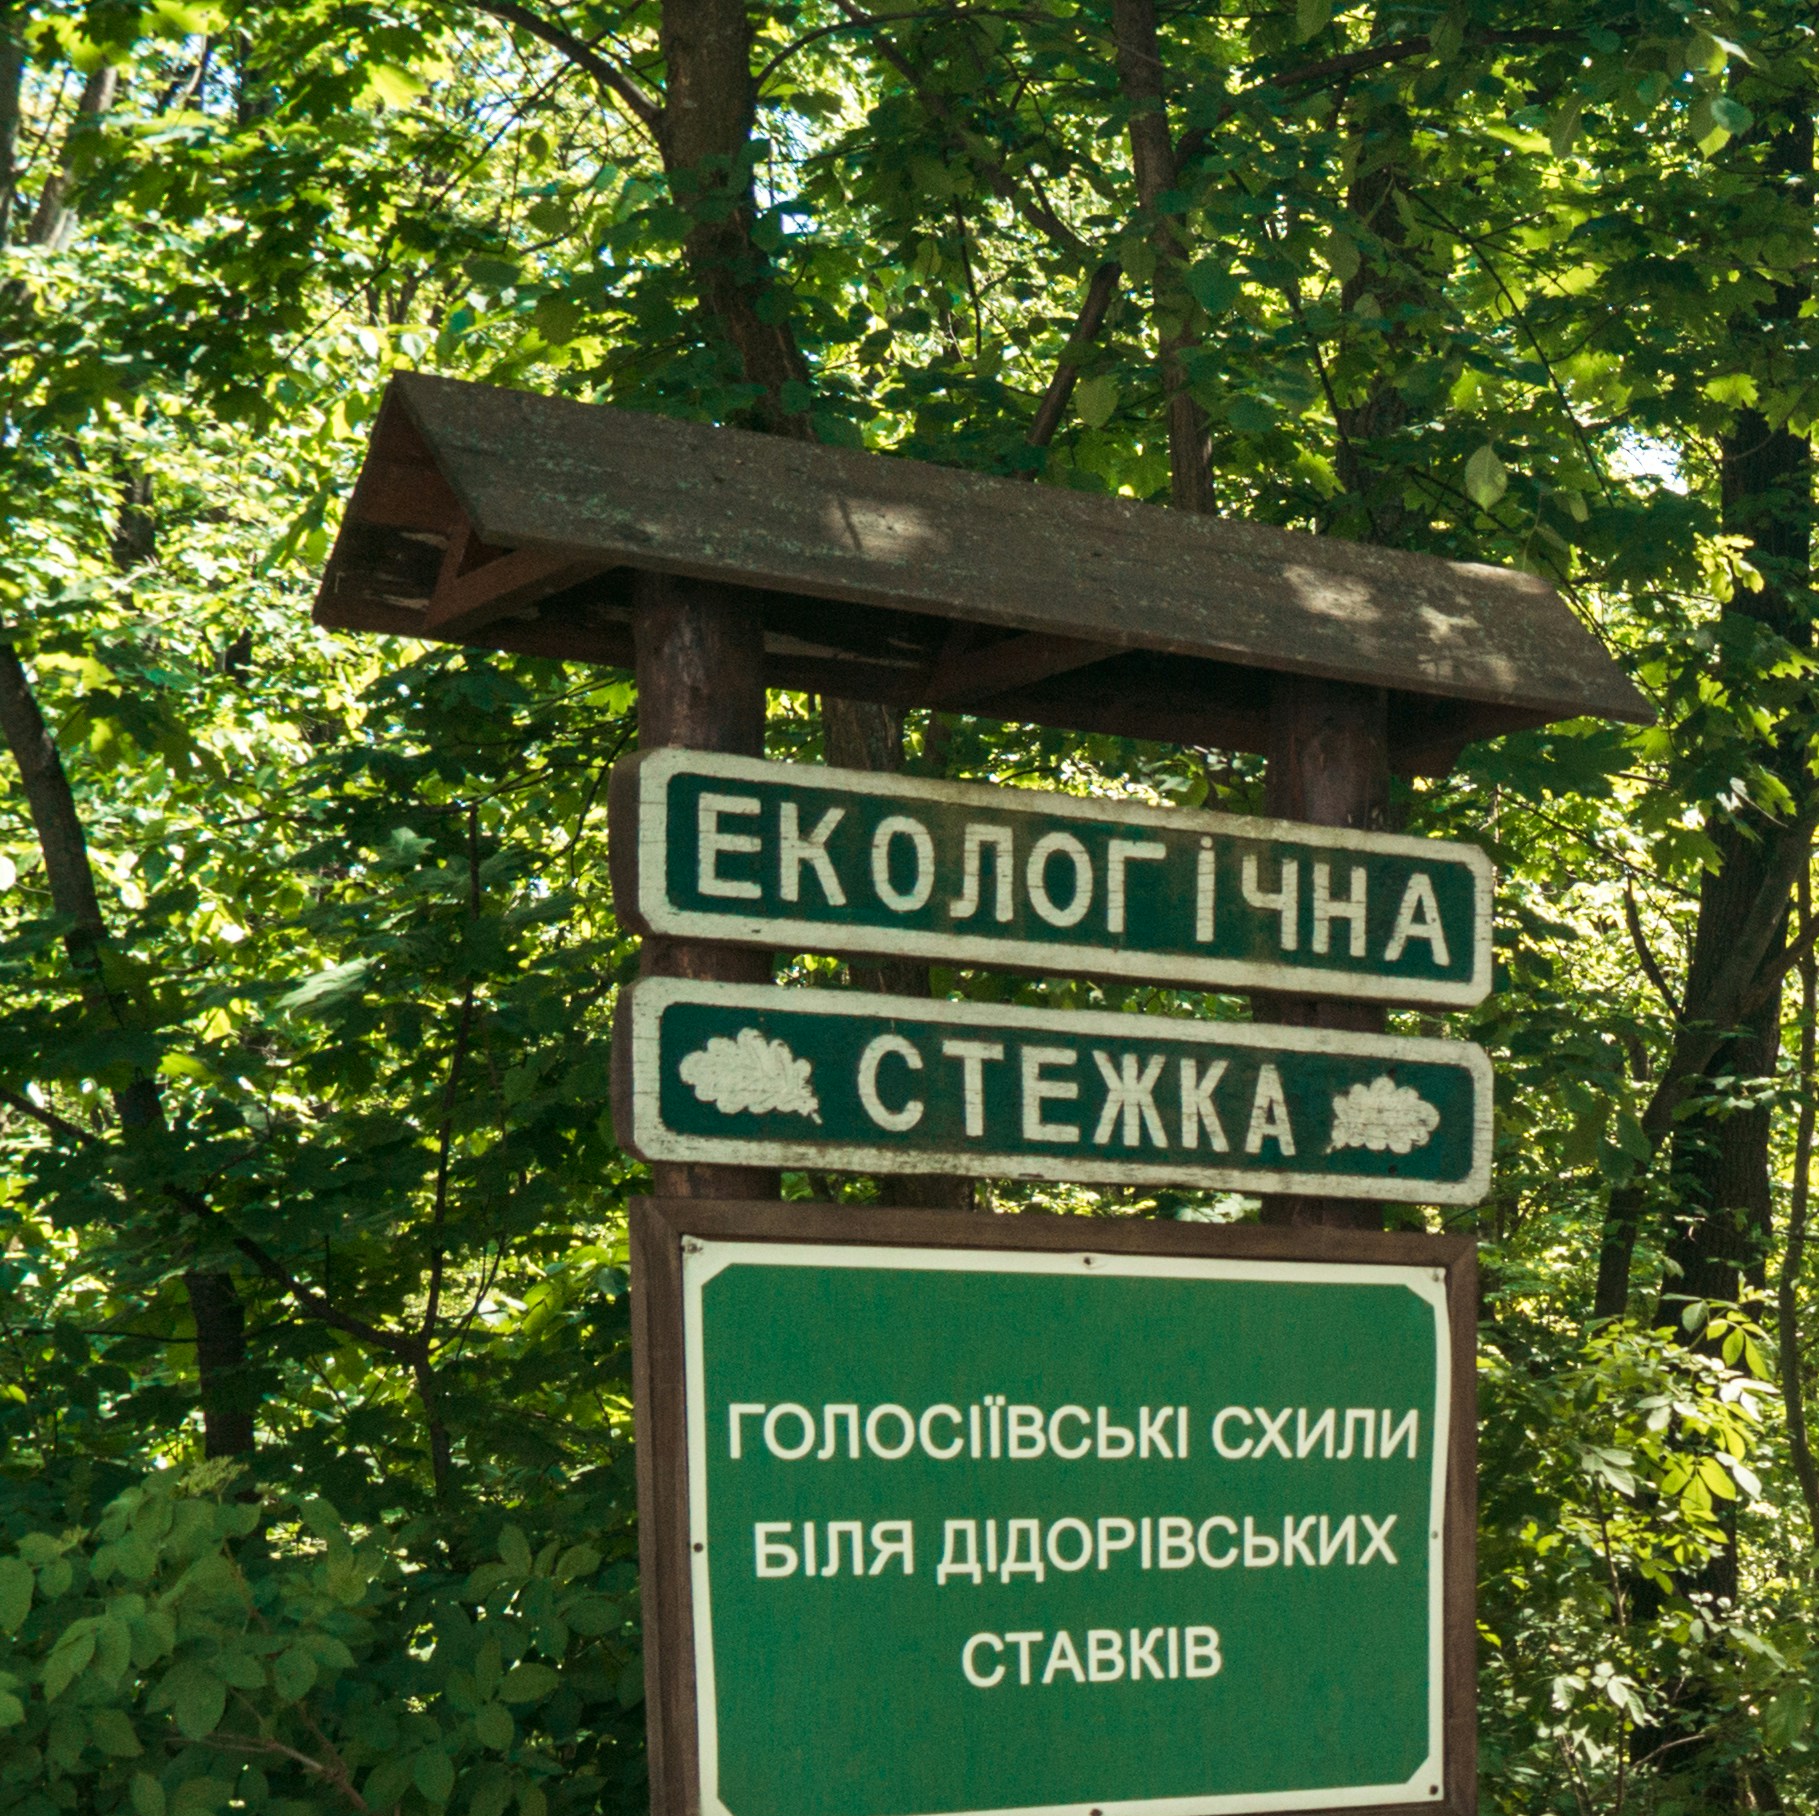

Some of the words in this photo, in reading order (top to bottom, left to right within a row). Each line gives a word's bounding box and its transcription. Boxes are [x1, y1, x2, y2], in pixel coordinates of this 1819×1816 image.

[857, 1033, 1296, 1157] СТЕЖКА
[729, 1394, 1189, 1461] ГОЛОСІЇВСЬКІ
[1212, 1405, 1419, 1460] СХИЛИ
[754, 1520, 914, 1578] БІЛЯ
[936, 1514, 1399, 1586] ДІДОРІВСЬКИХ
[962, 1625, 1223, 1689] СТАВКІВ
